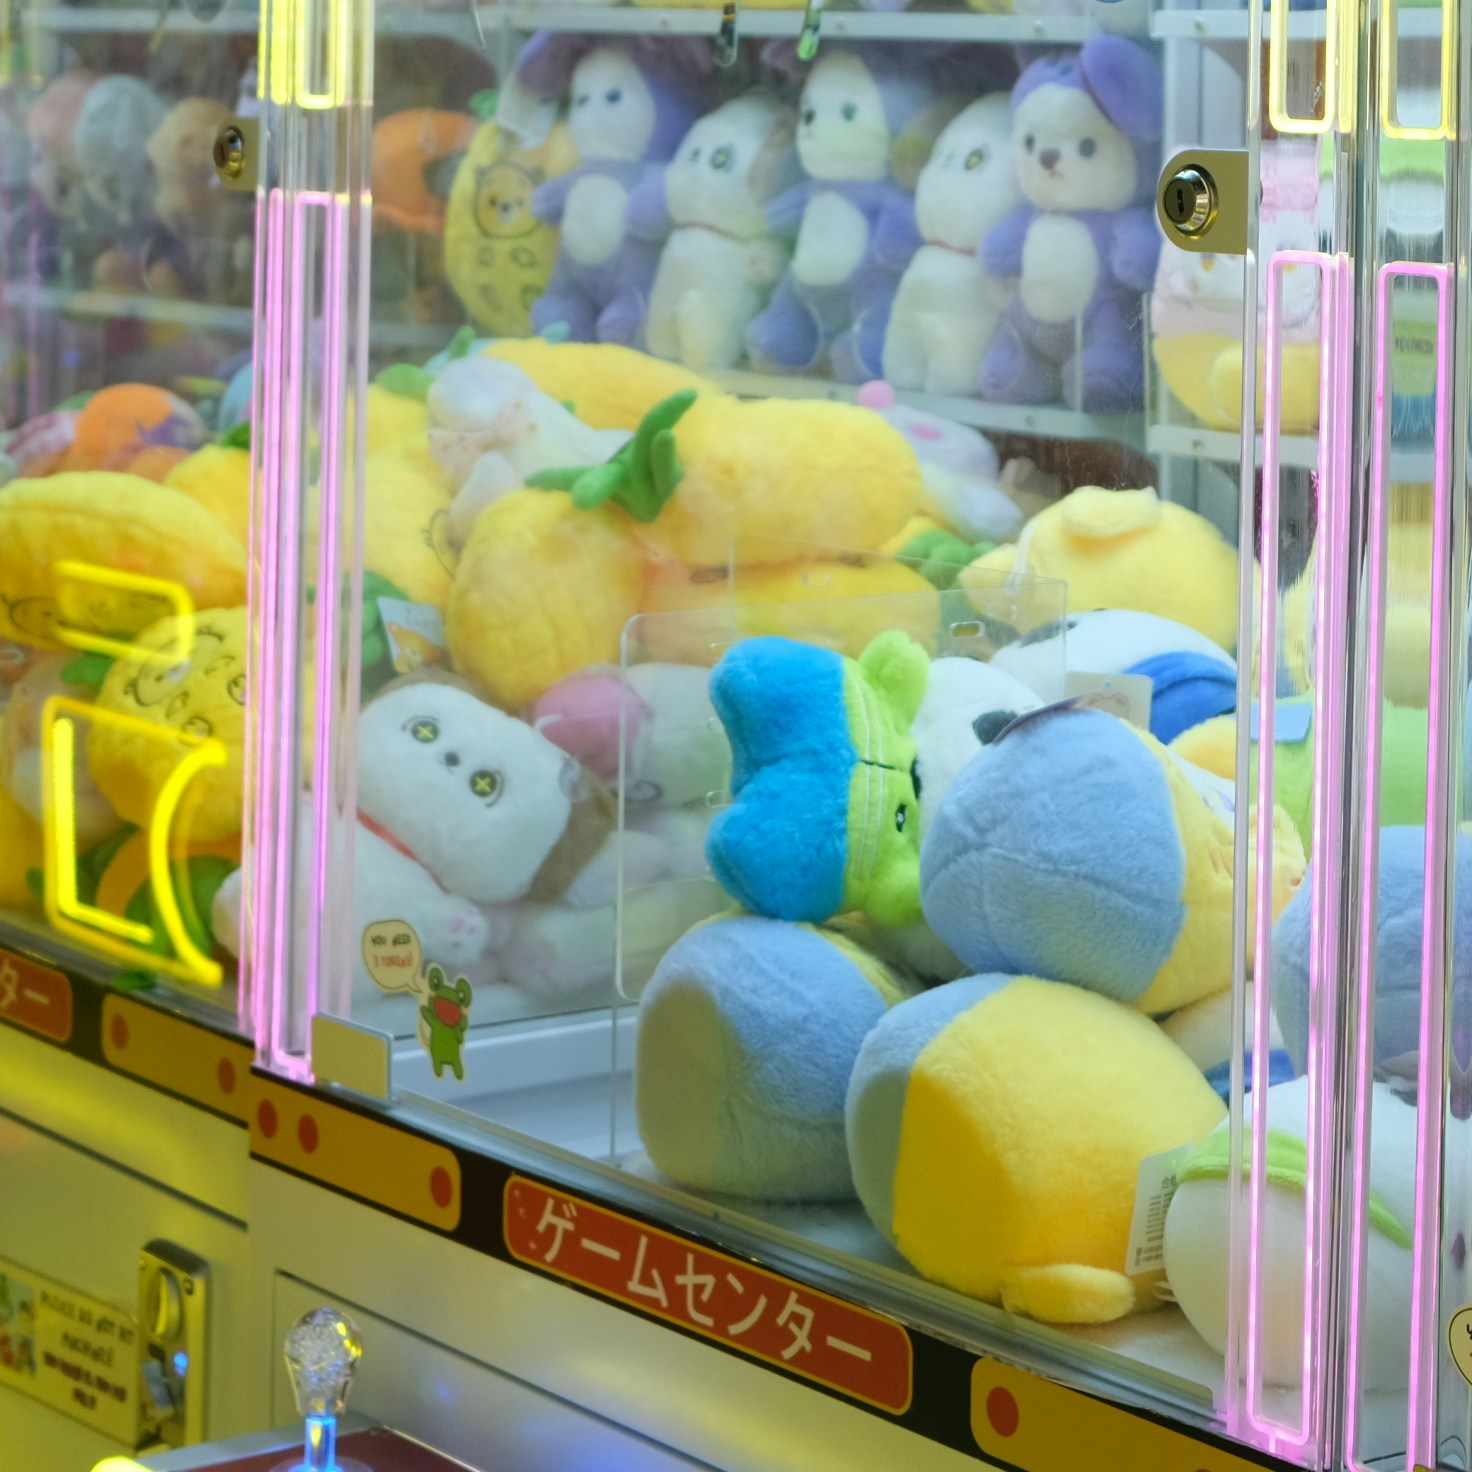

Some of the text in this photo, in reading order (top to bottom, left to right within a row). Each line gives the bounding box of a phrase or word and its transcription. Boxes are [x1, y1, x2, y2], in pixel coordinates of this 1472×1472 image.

[536, 1197, 872, 1362] ゲームセンター
